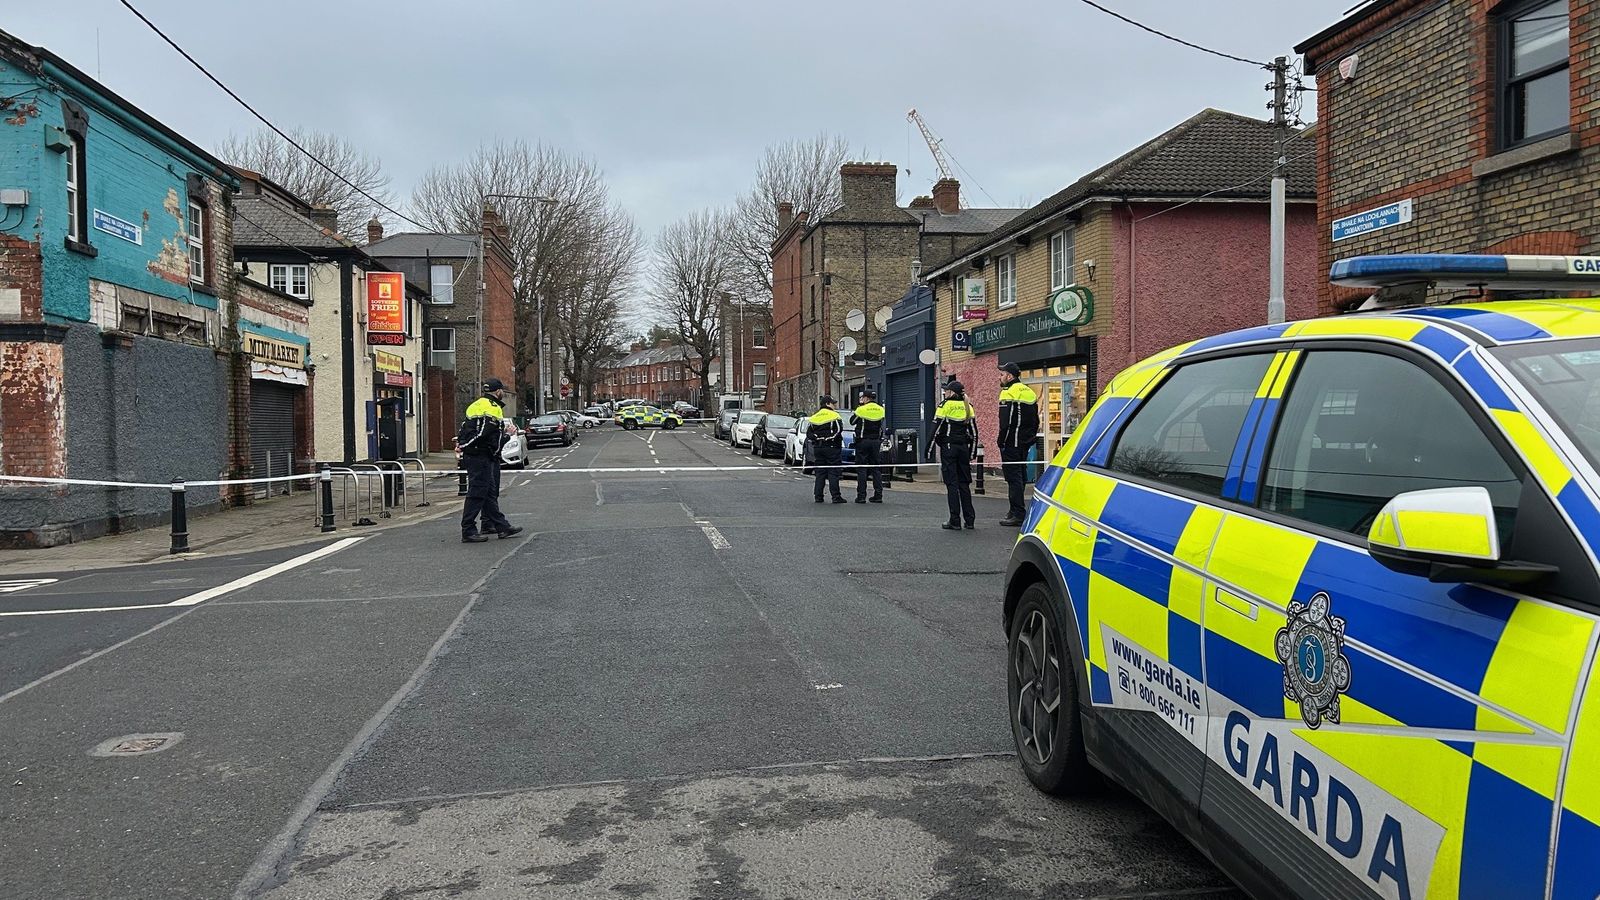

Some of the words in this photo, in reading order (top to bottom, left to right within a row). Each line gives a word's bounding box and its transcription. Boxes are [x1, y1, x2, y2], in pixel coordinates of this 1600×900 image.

[248, 338, 270, 359] MINI
[270, 343, 299, 364] MARKET
[368, 334, 404, 344] OPEN
[975, 330, 985, 344] THE
[1111, 637, 1200, 710] www.garda.ie
[1132, 678, 1137, 695] 1
[1139, 684, 1156, 707] 800
[1158, 696, 1176, 720] 666
[1178, 708, 1194, 736] 111
[1223, 710, 1411, 900] GARDA
